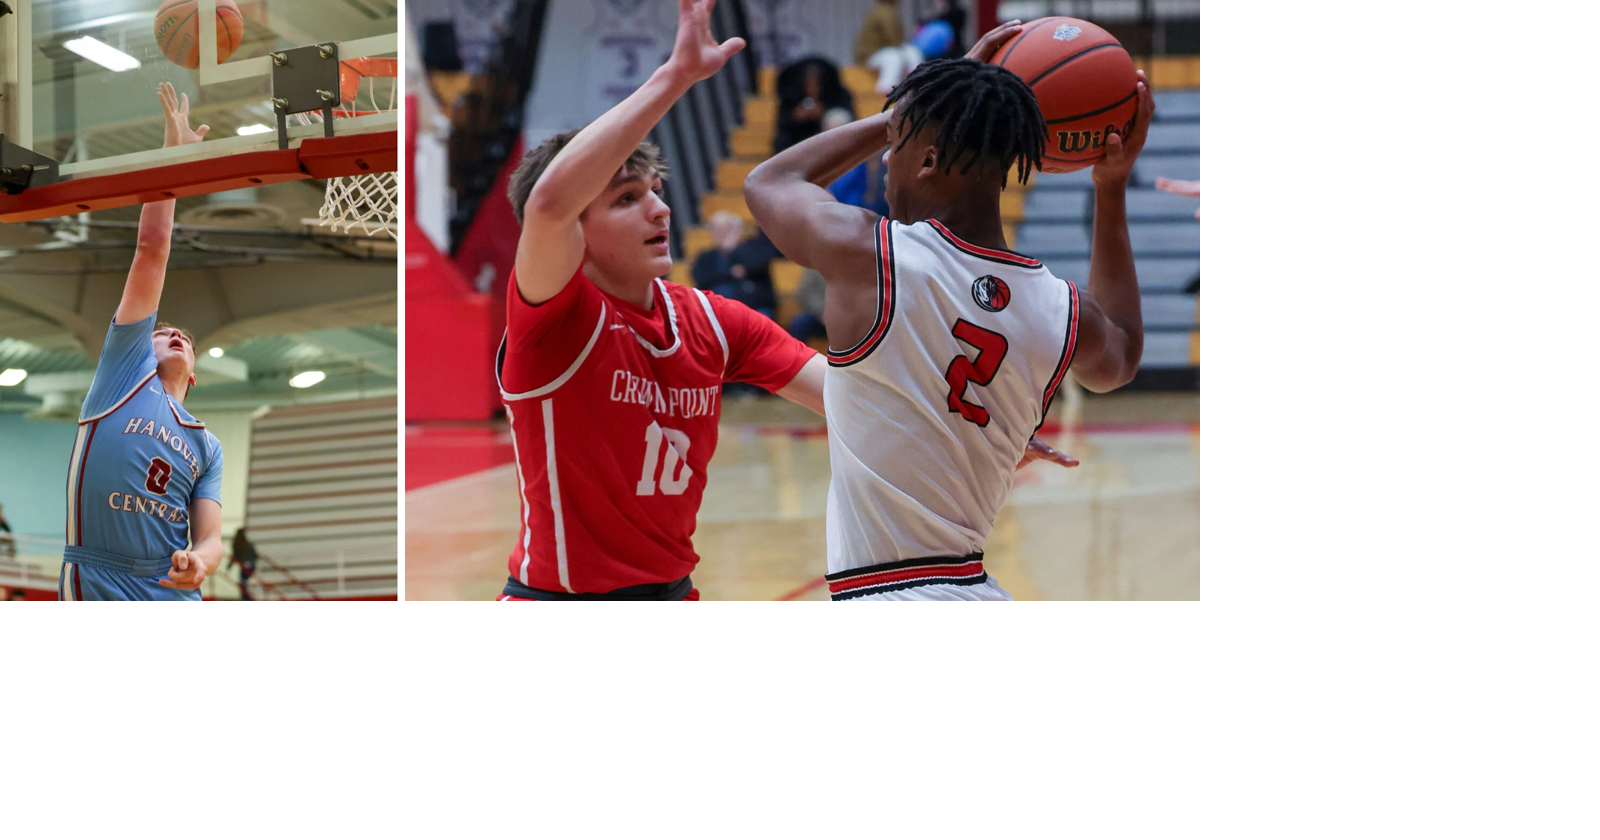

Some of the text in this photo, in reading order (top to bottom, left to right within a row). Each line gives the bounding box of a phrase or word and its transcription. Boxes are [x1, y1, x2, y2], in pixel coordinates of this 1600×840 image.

[944, 317, 1009, 428] 2
[667, 385, 719, 419] POINT
[144, 456, 172, 496] 0
[636, 419, 693, 496] 10
